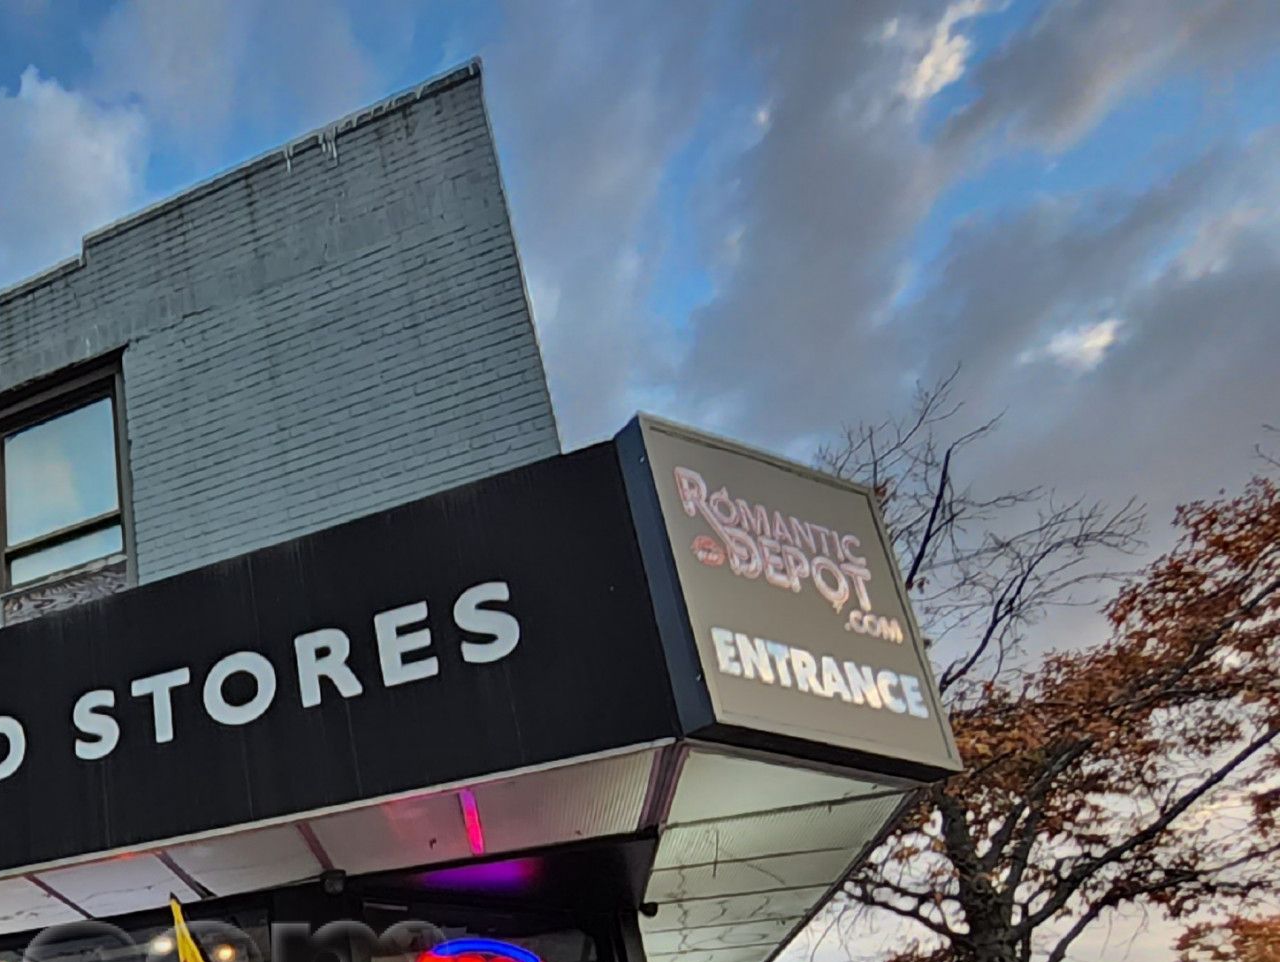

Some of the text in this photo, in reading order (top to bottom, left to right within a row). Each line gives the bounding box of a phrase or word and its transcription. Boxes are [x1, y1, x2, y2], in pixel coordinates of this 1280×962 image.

[673, 466, 866, 567] ROMANTIC
[725, 526, 871, 612] DEPOT
[72, 581, 521, 761] STORES
[710, 627, 930, 718] ENTRANCE
